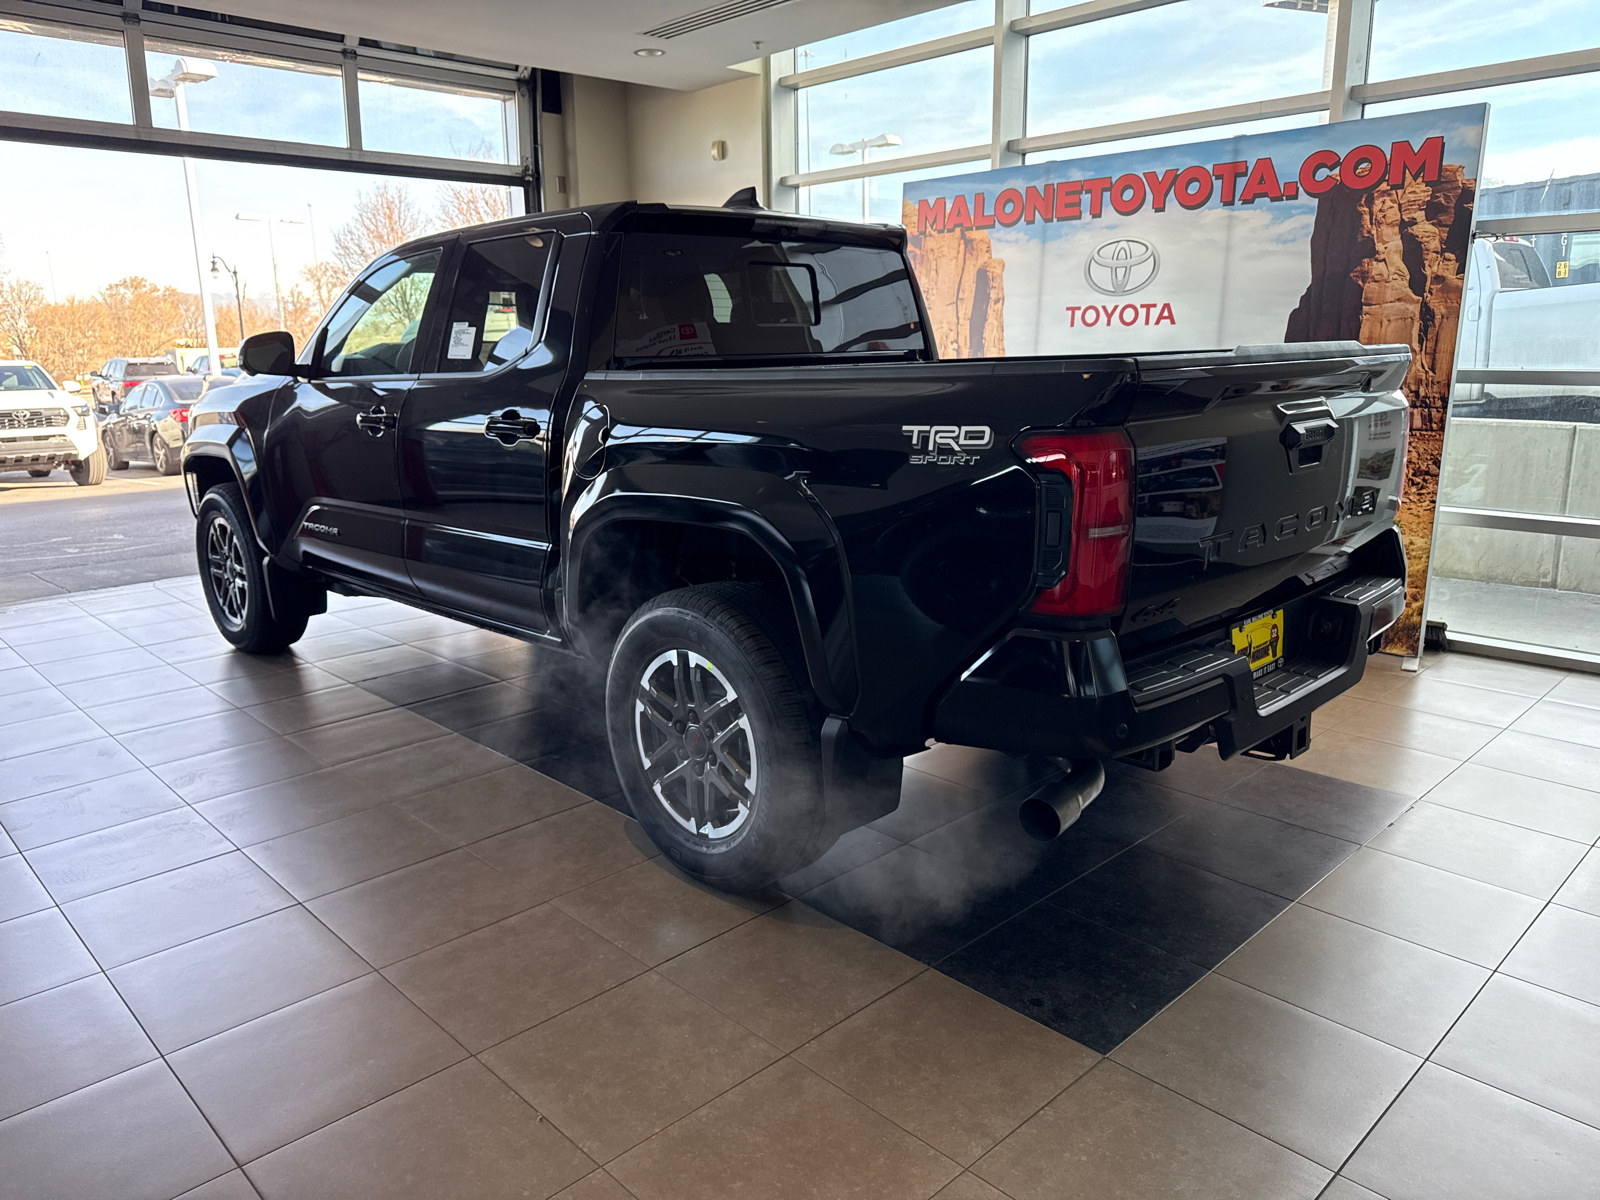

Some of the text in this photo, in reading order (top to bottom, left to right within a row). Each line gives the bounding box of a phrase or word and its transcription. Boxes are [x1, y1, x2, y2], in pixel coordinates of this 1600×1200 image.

[917, 135, 1445, 237] MALONETOYOTA.COM
[1065, 302, 1177, 328] TOYOTA
[901, 425, 995, 455] TRD
[908, 454, 981, 466] SPORT
[302, 521, 340, 537] TACOMA
[1198, 489, 1376, 571] TACOMA
